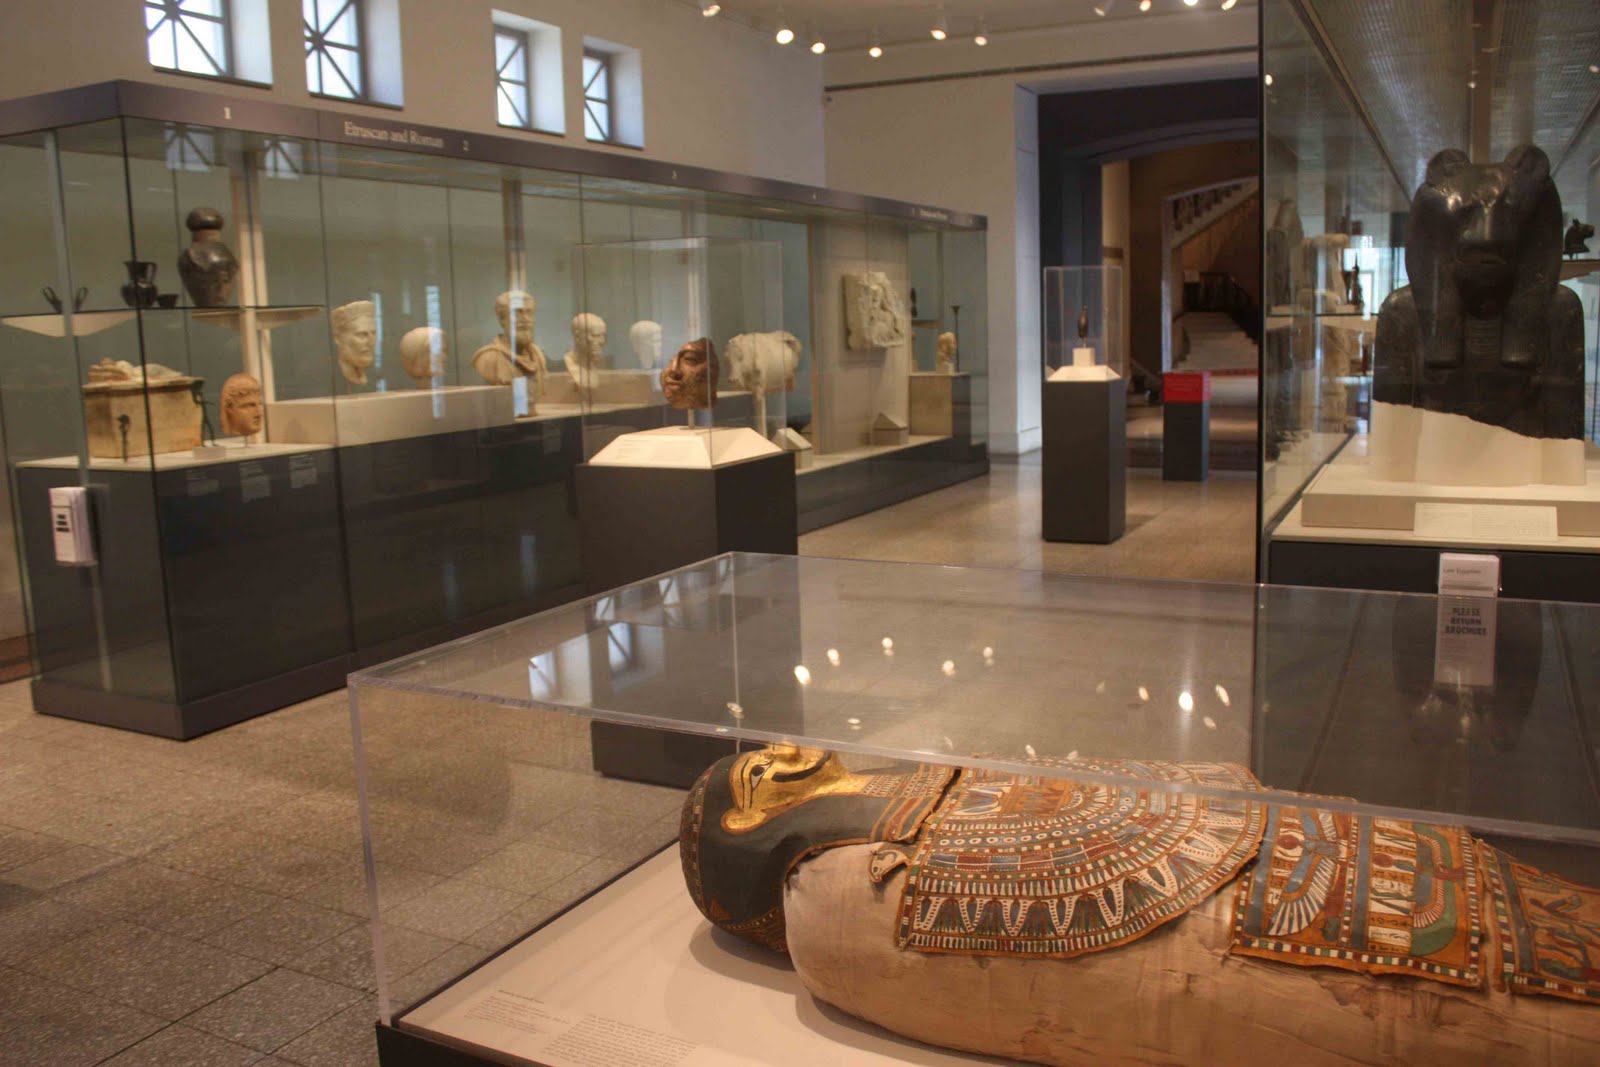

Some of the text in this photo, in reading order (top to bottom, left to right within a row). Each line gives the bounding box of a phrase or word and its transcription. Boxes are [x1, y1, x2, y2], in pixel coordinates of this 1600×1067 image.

[344, 121, 444, 148] Etruscan and Roman
[1452, 607, 1480, 616] PLEASE
[1450, 617, 1482, 625] RETURN
